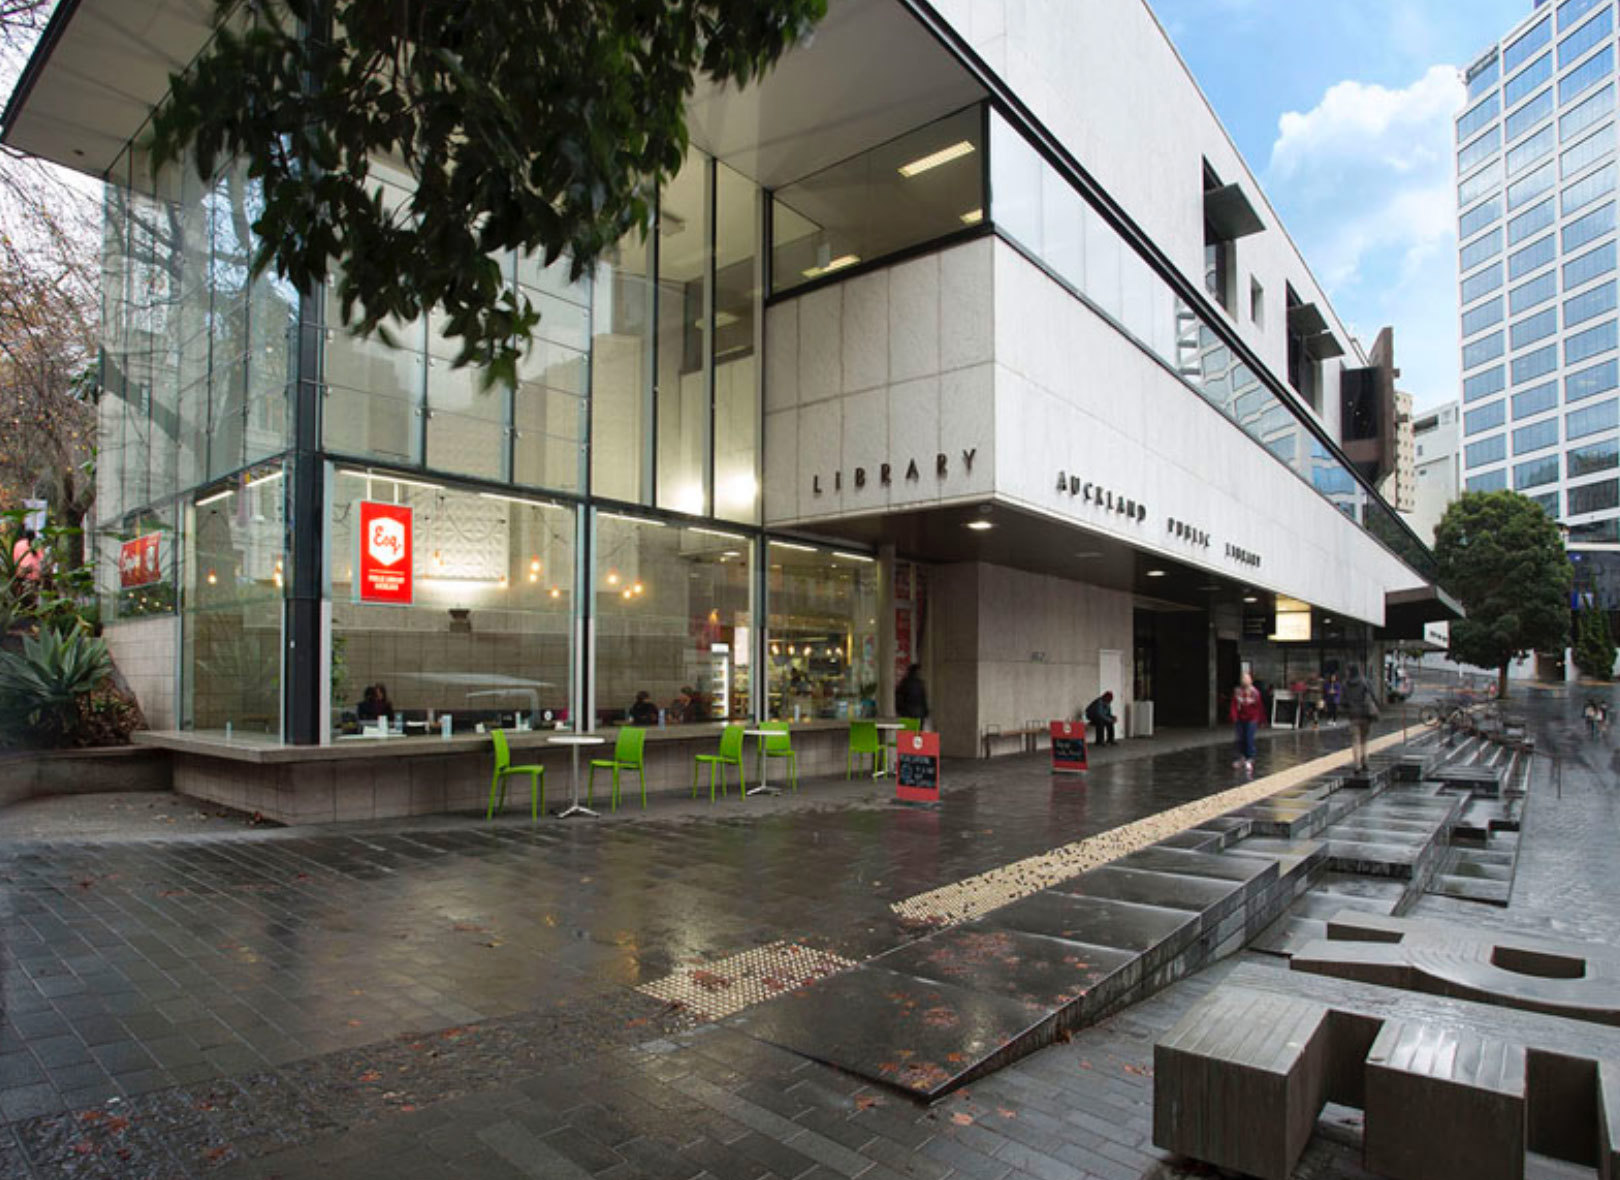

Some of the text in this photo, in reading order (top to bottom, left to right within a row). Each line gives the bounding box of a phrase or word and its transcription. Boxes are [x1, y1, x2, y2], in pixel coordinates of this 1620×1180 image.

[812, 448, 977, 494] LIBRARY
[1056, 471, 1261, 568] AUCKLAND PUBLIC LIBRARY
